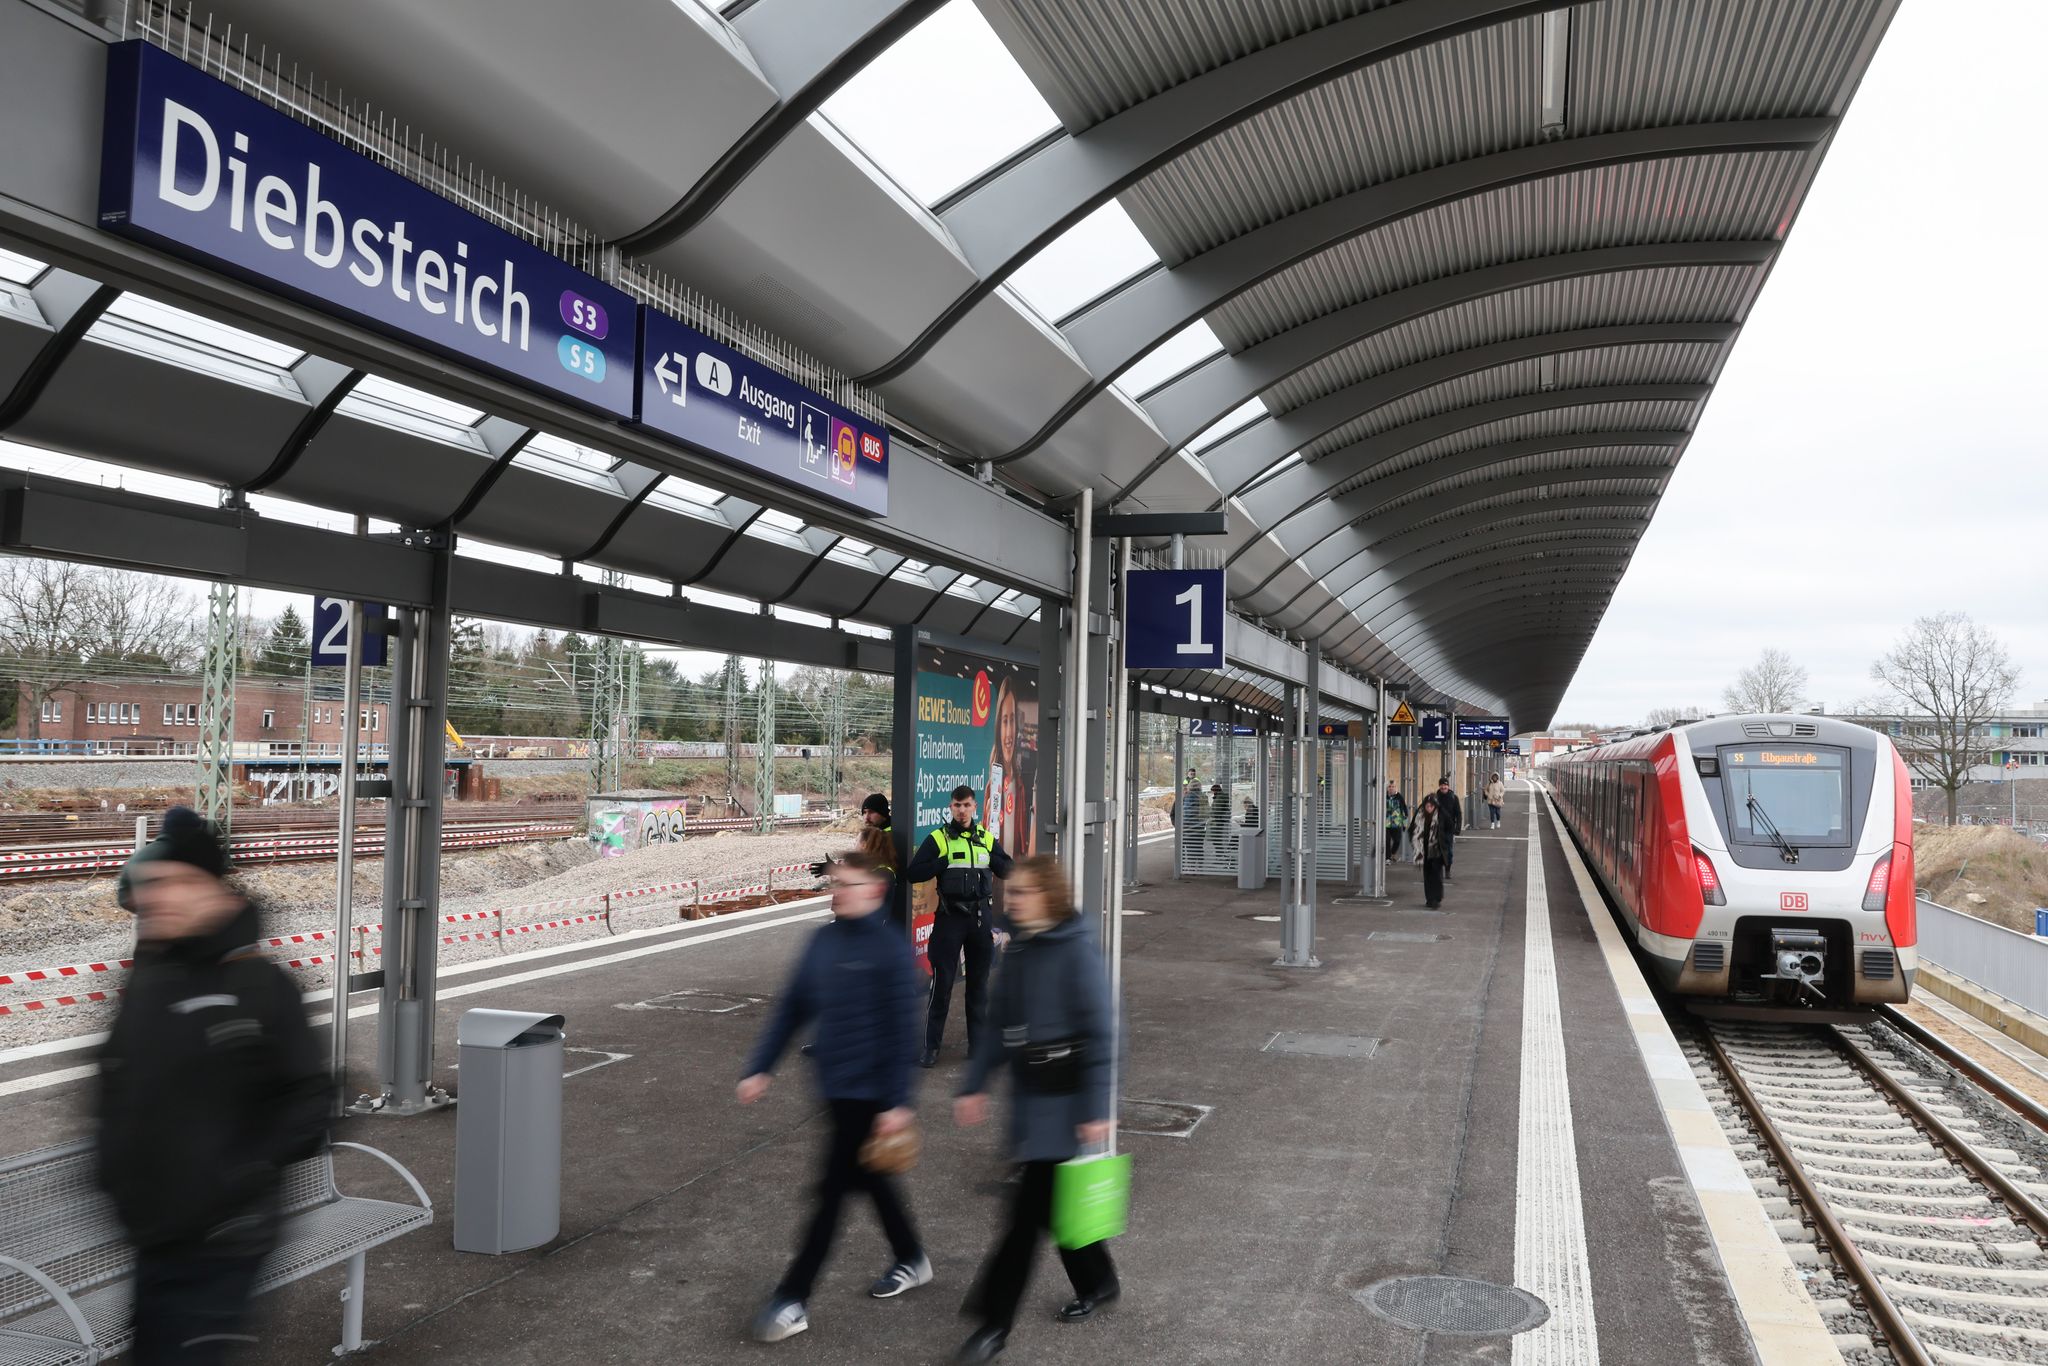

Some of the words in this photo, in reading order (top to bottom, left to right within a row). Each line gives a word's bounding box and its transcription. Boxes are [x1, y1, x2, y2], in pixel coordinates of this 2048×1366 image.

[158, 97, 531, 352] Diebsteich
[573, 299, 597, 331] S3
[708, 361, 719, 389] A
[739, 375, 795, 429] Ausgang
[738, 416, 761, 446] Exit
[863, 435, 880, 459] BUS
[319, 597, 349, 654] 2
[1175, 584, 1214, 654] 1
[918, 695, 946, 723] REWE
[947, 700, 971, 726] Bonus
[1192, 718, 1203, 734] 2
[1434, 721, 1445, 739] 1
[918, 733, 966, 763] Teilnehmen,
[1760, 752, 1817, 765] Elbgaustraße
[916, 768, 934, 799] App
[970, 768, 985, 791] und
[916, 802, 941, 827] Euros
[1783, 895, 1806, 908] DB
[916, 923, 934, 943] REW
[1860, 931, 1887, 942] hvv
